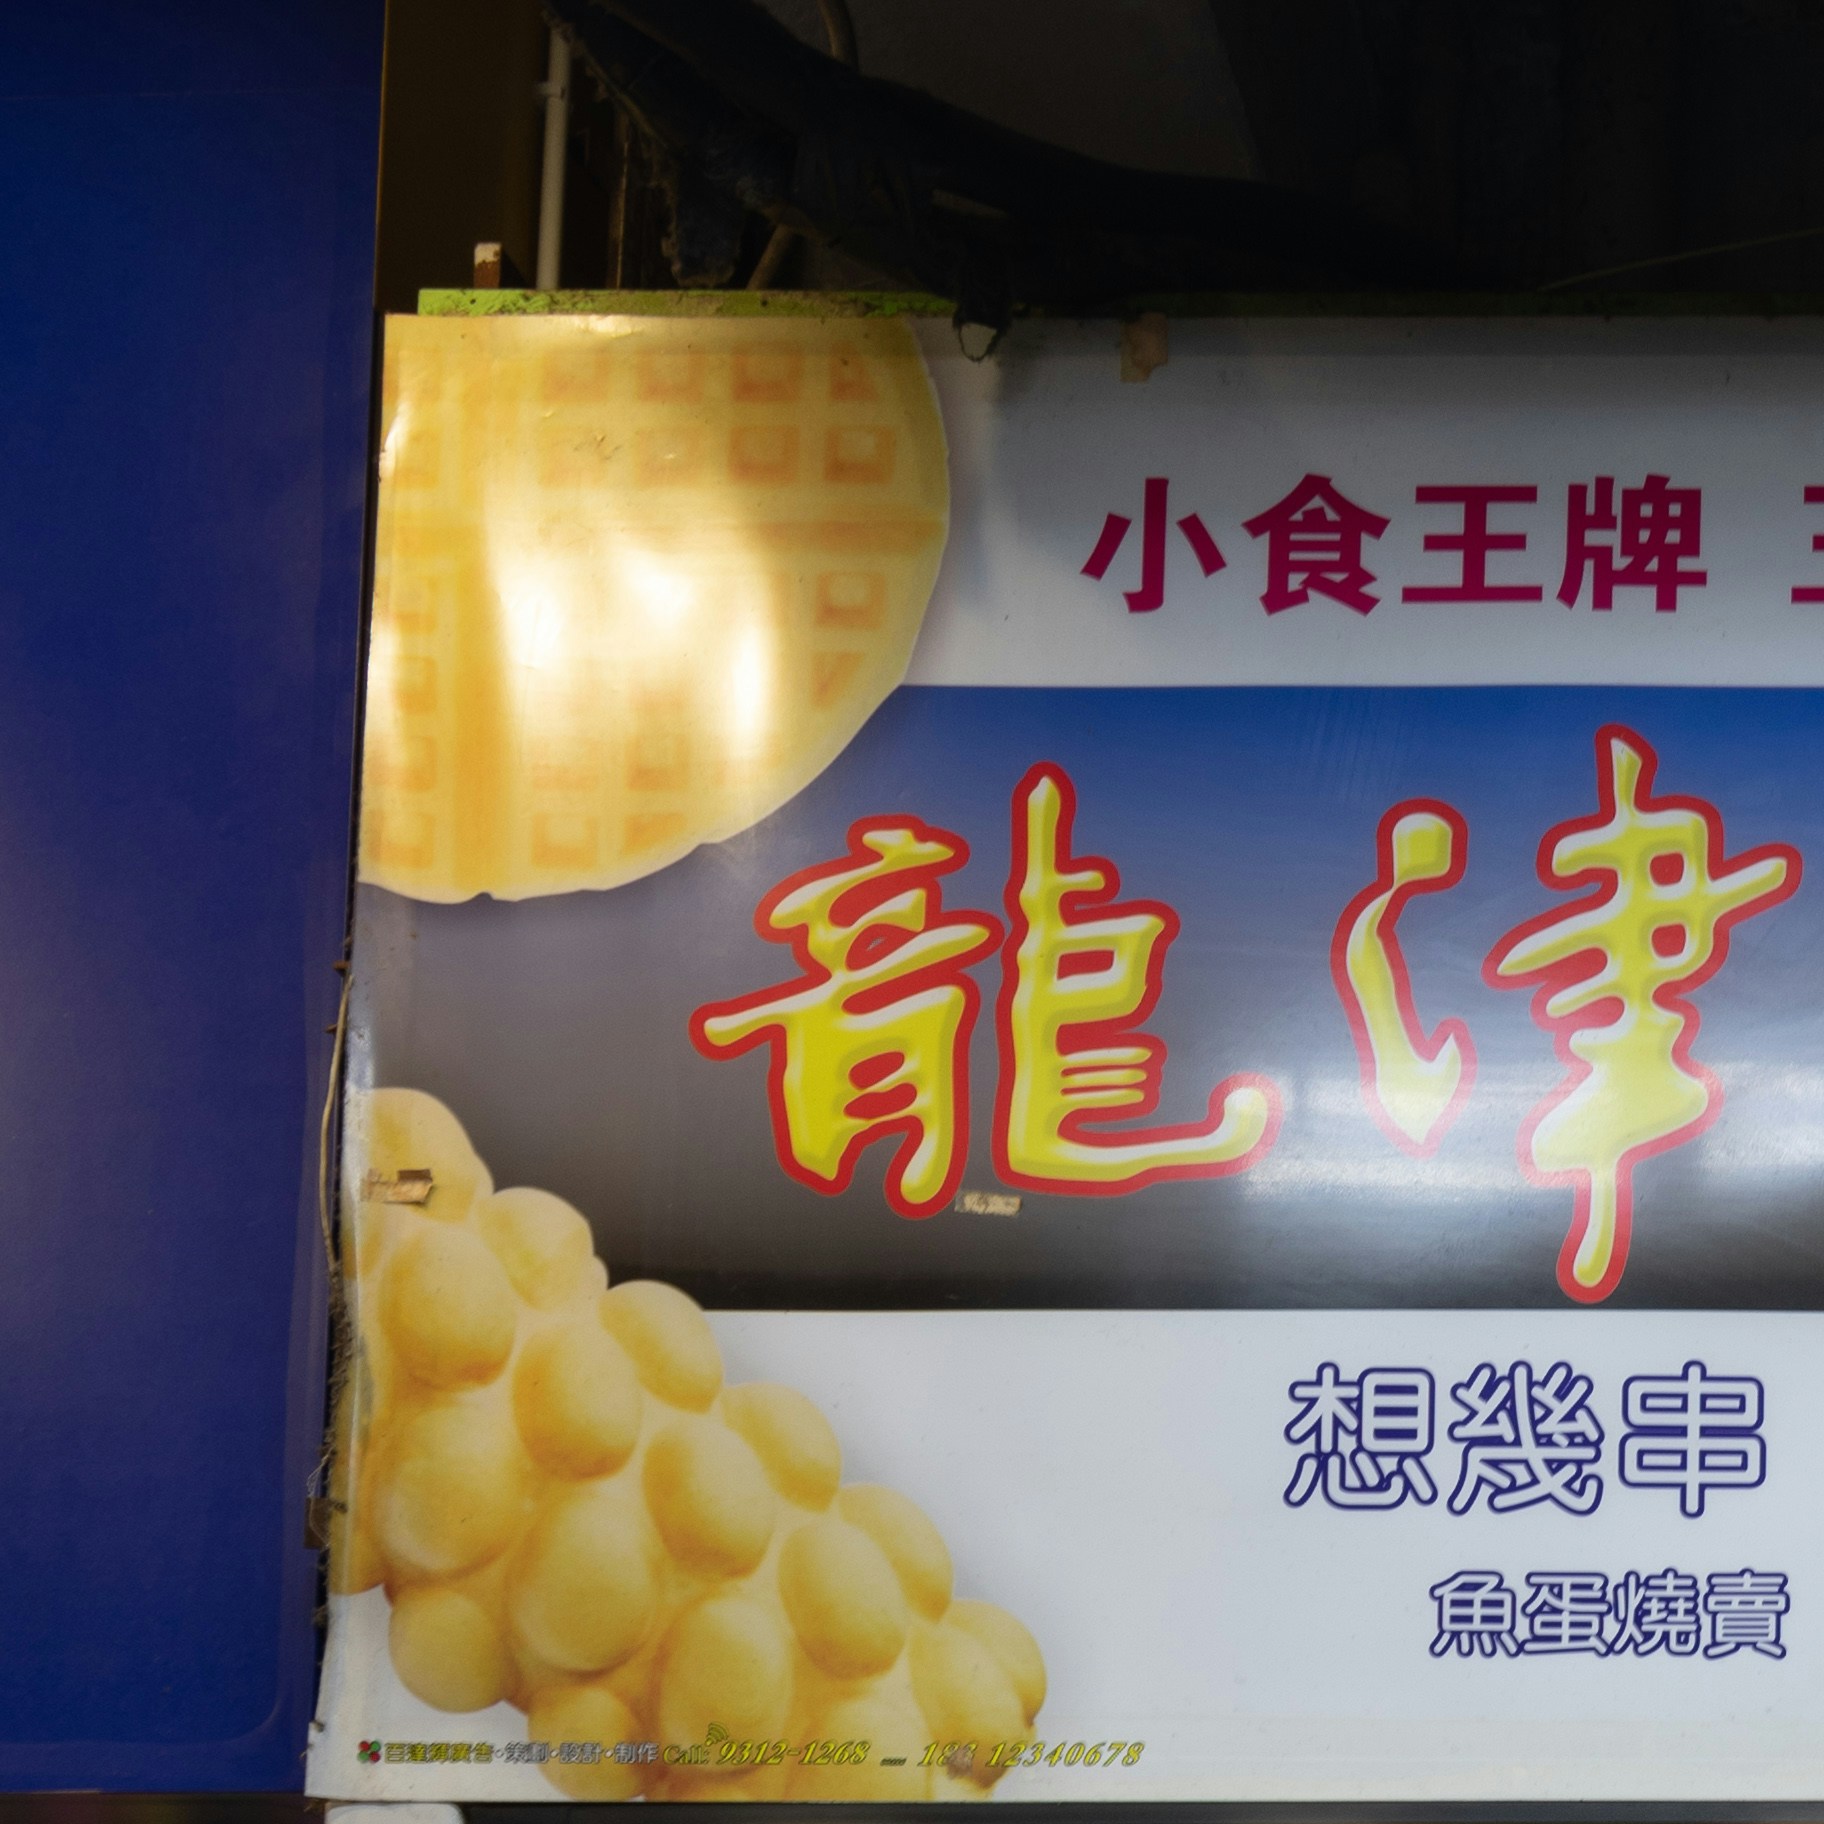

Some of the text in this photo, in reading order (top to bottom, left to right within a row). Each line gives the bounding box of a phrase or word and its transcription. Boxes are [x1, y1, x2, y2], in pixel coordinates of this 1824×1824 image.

[1083, 476, 1707, 614] 小食王牌
[1286, 1361, 1768, 1519] 想幾串
[1431, 1571, 1791, 1659] 魚蛋燒賣
[717, 1740, 871, 1766] 9312-1268
